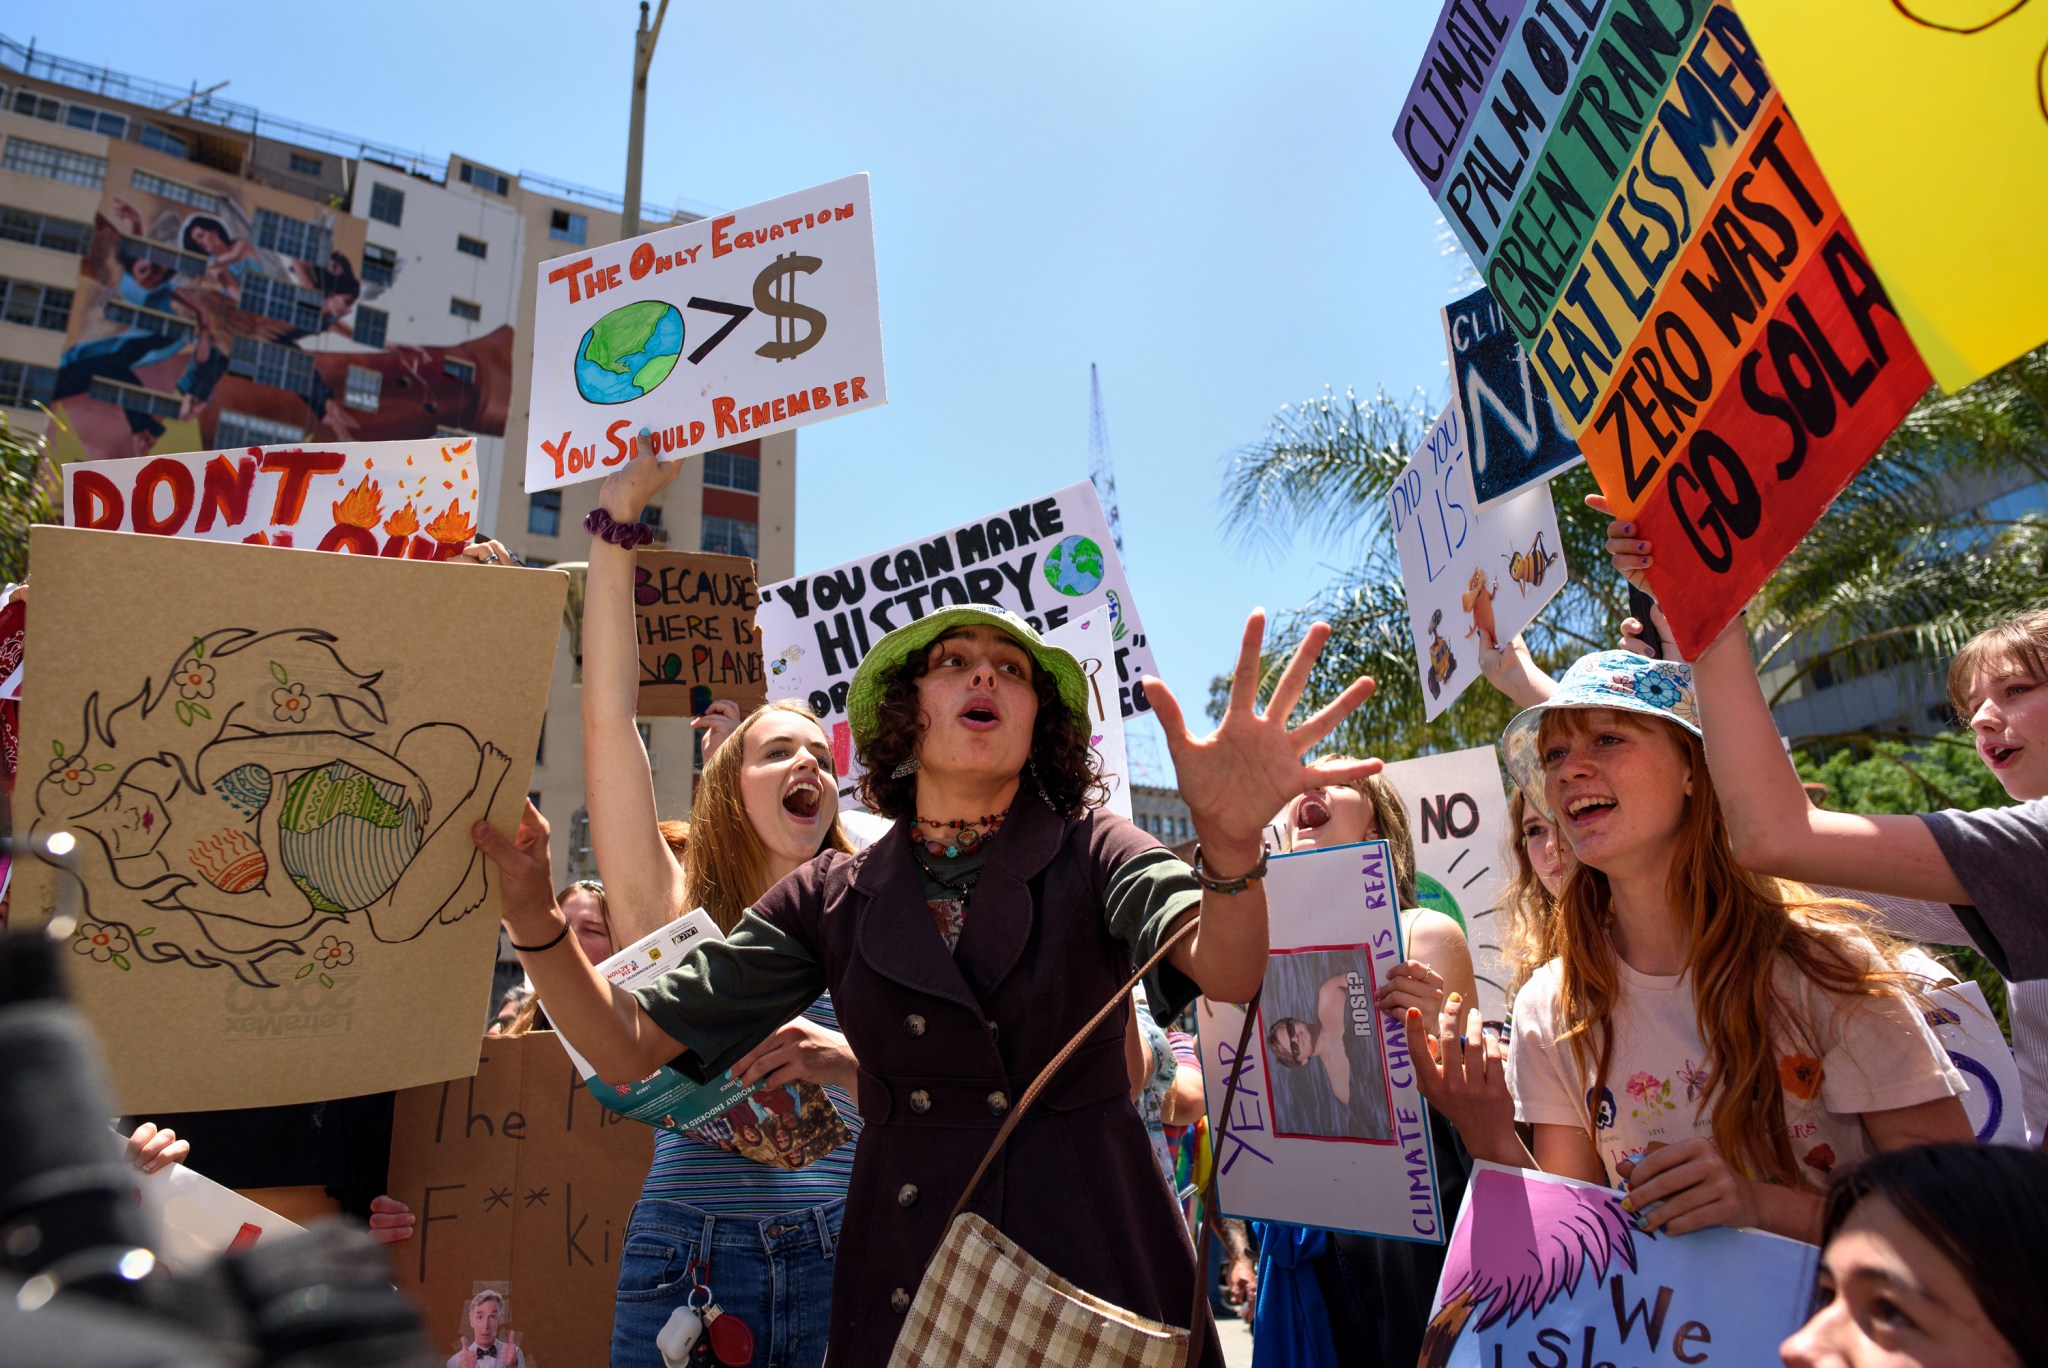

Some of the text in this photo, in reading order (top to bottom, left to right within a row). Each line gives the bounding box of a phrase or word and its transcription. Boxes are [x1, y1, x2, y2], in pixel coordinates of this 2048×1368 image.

[1446, 69, 1547, 256] PALM
[549, 203, 855, 305] THE ONLY EQUATION
[1486, 151, 1597, 339] GREEN
[1534, 263, 1623, 425] EAT
[1591, 125, 1691, 323] LESS
[1452, 301, 1506, 352] CLI
[1593, 103, 1825, 503] ZERO WAST
[540, 431, 596, 480] YOU
[712, 376, 869, 439] REMEMBER
[1465, 341, 1576, 475] N
[1667, 230, 1901, 574] GO SOLA
[72, 446, 347, 537] DON'T
[1391, 410, 1459, 533] DID YOU
[1416, 450, 1480, 583] LIS
[634, 566, 757, 612] BECAUSE
[870, 534, 954, 592] CAN
[954, 497, 1065, 568] MAKE
[691, 643, 764, 686] PLANET
[732, 617, 754, 646] IS
[1420, 792, 1480, 844] NO
[1346, 970, 1373, 1038] ROSE?
[1361, 844, 1437, 1237] CLIMATE CHAN IS REAL
[688, 1103, 725, 1128] ENDORSED
[725, 1083, 756, 1106] PROUDLY
[1648, 1126, 1667, 1137] LOVE
[1610, 1273, 1712, 1365] We
